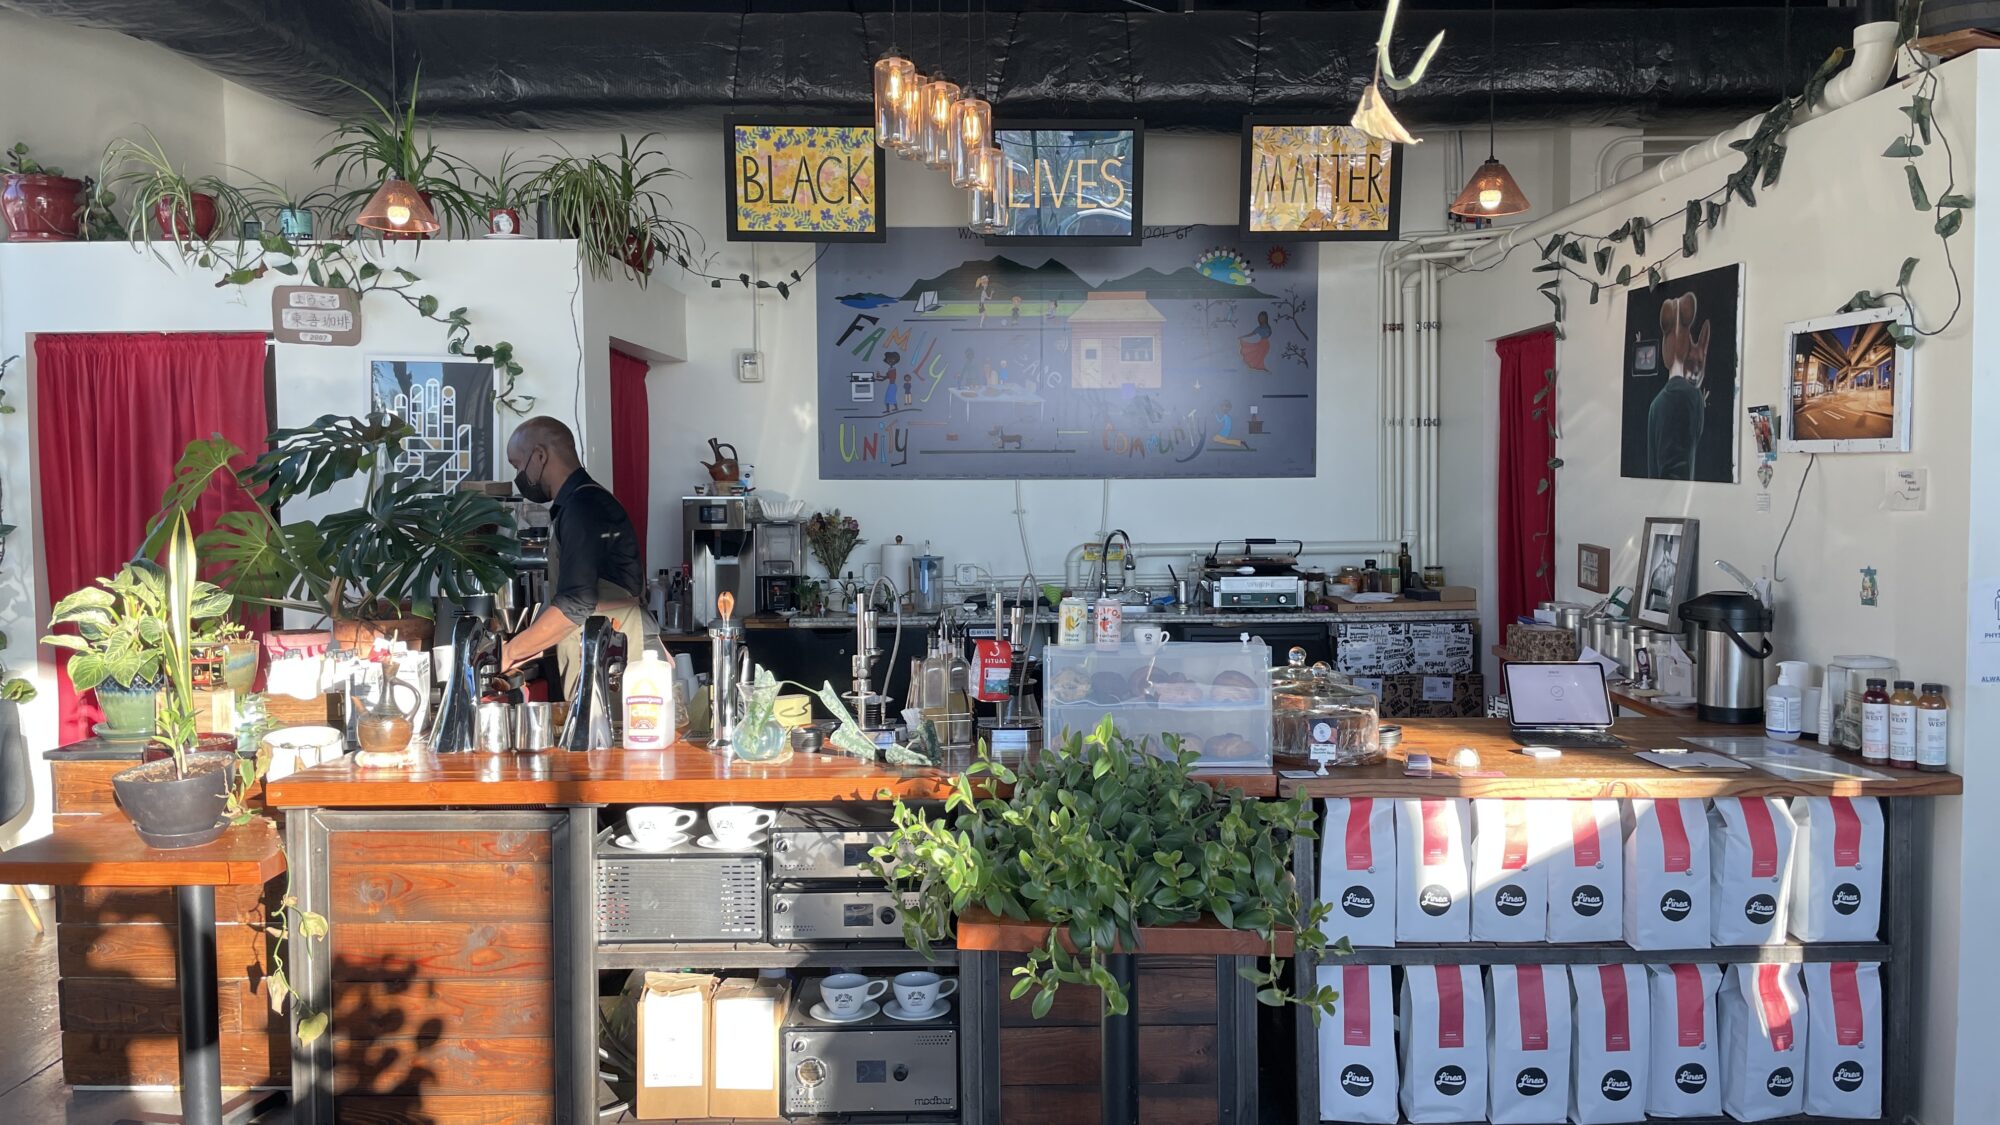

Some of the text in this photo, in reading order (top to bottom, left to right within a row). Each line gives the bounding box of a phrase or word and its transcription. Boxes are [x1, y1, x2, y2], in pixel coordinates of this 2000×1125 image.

[742, 155, 870, 205] BLACK
[1007, 158, 1125, 209] LIVES
[1256, 153, 1384, 204] MATTER
[1343, 892, 1373, 908] Linea
[1421, 891, 1450, 907] Linea
[1497, 891, 1525, 907] Linea
[1574, 891, 1602, 907] Linea
[1662, 897, 1690, 912] Linea
[1832, 891, 1860, 906] Linea
[1746, 901, 1775, 916] Linea
[1342, 1070, 1372, 1087] Linea
[1435, 1071, 1466, 1087] Linea
[1517, 1074, 1547, 1088] Linea
[1676, 1070, 1705, 1085] Linea
[1768, 1073, 1793, 1088] Linea
[1833, 1068, 1863, 1083] Linea
[1602, 1077, 1631, 1092] Linea
[914, 1095, 953, 1106] modbar
